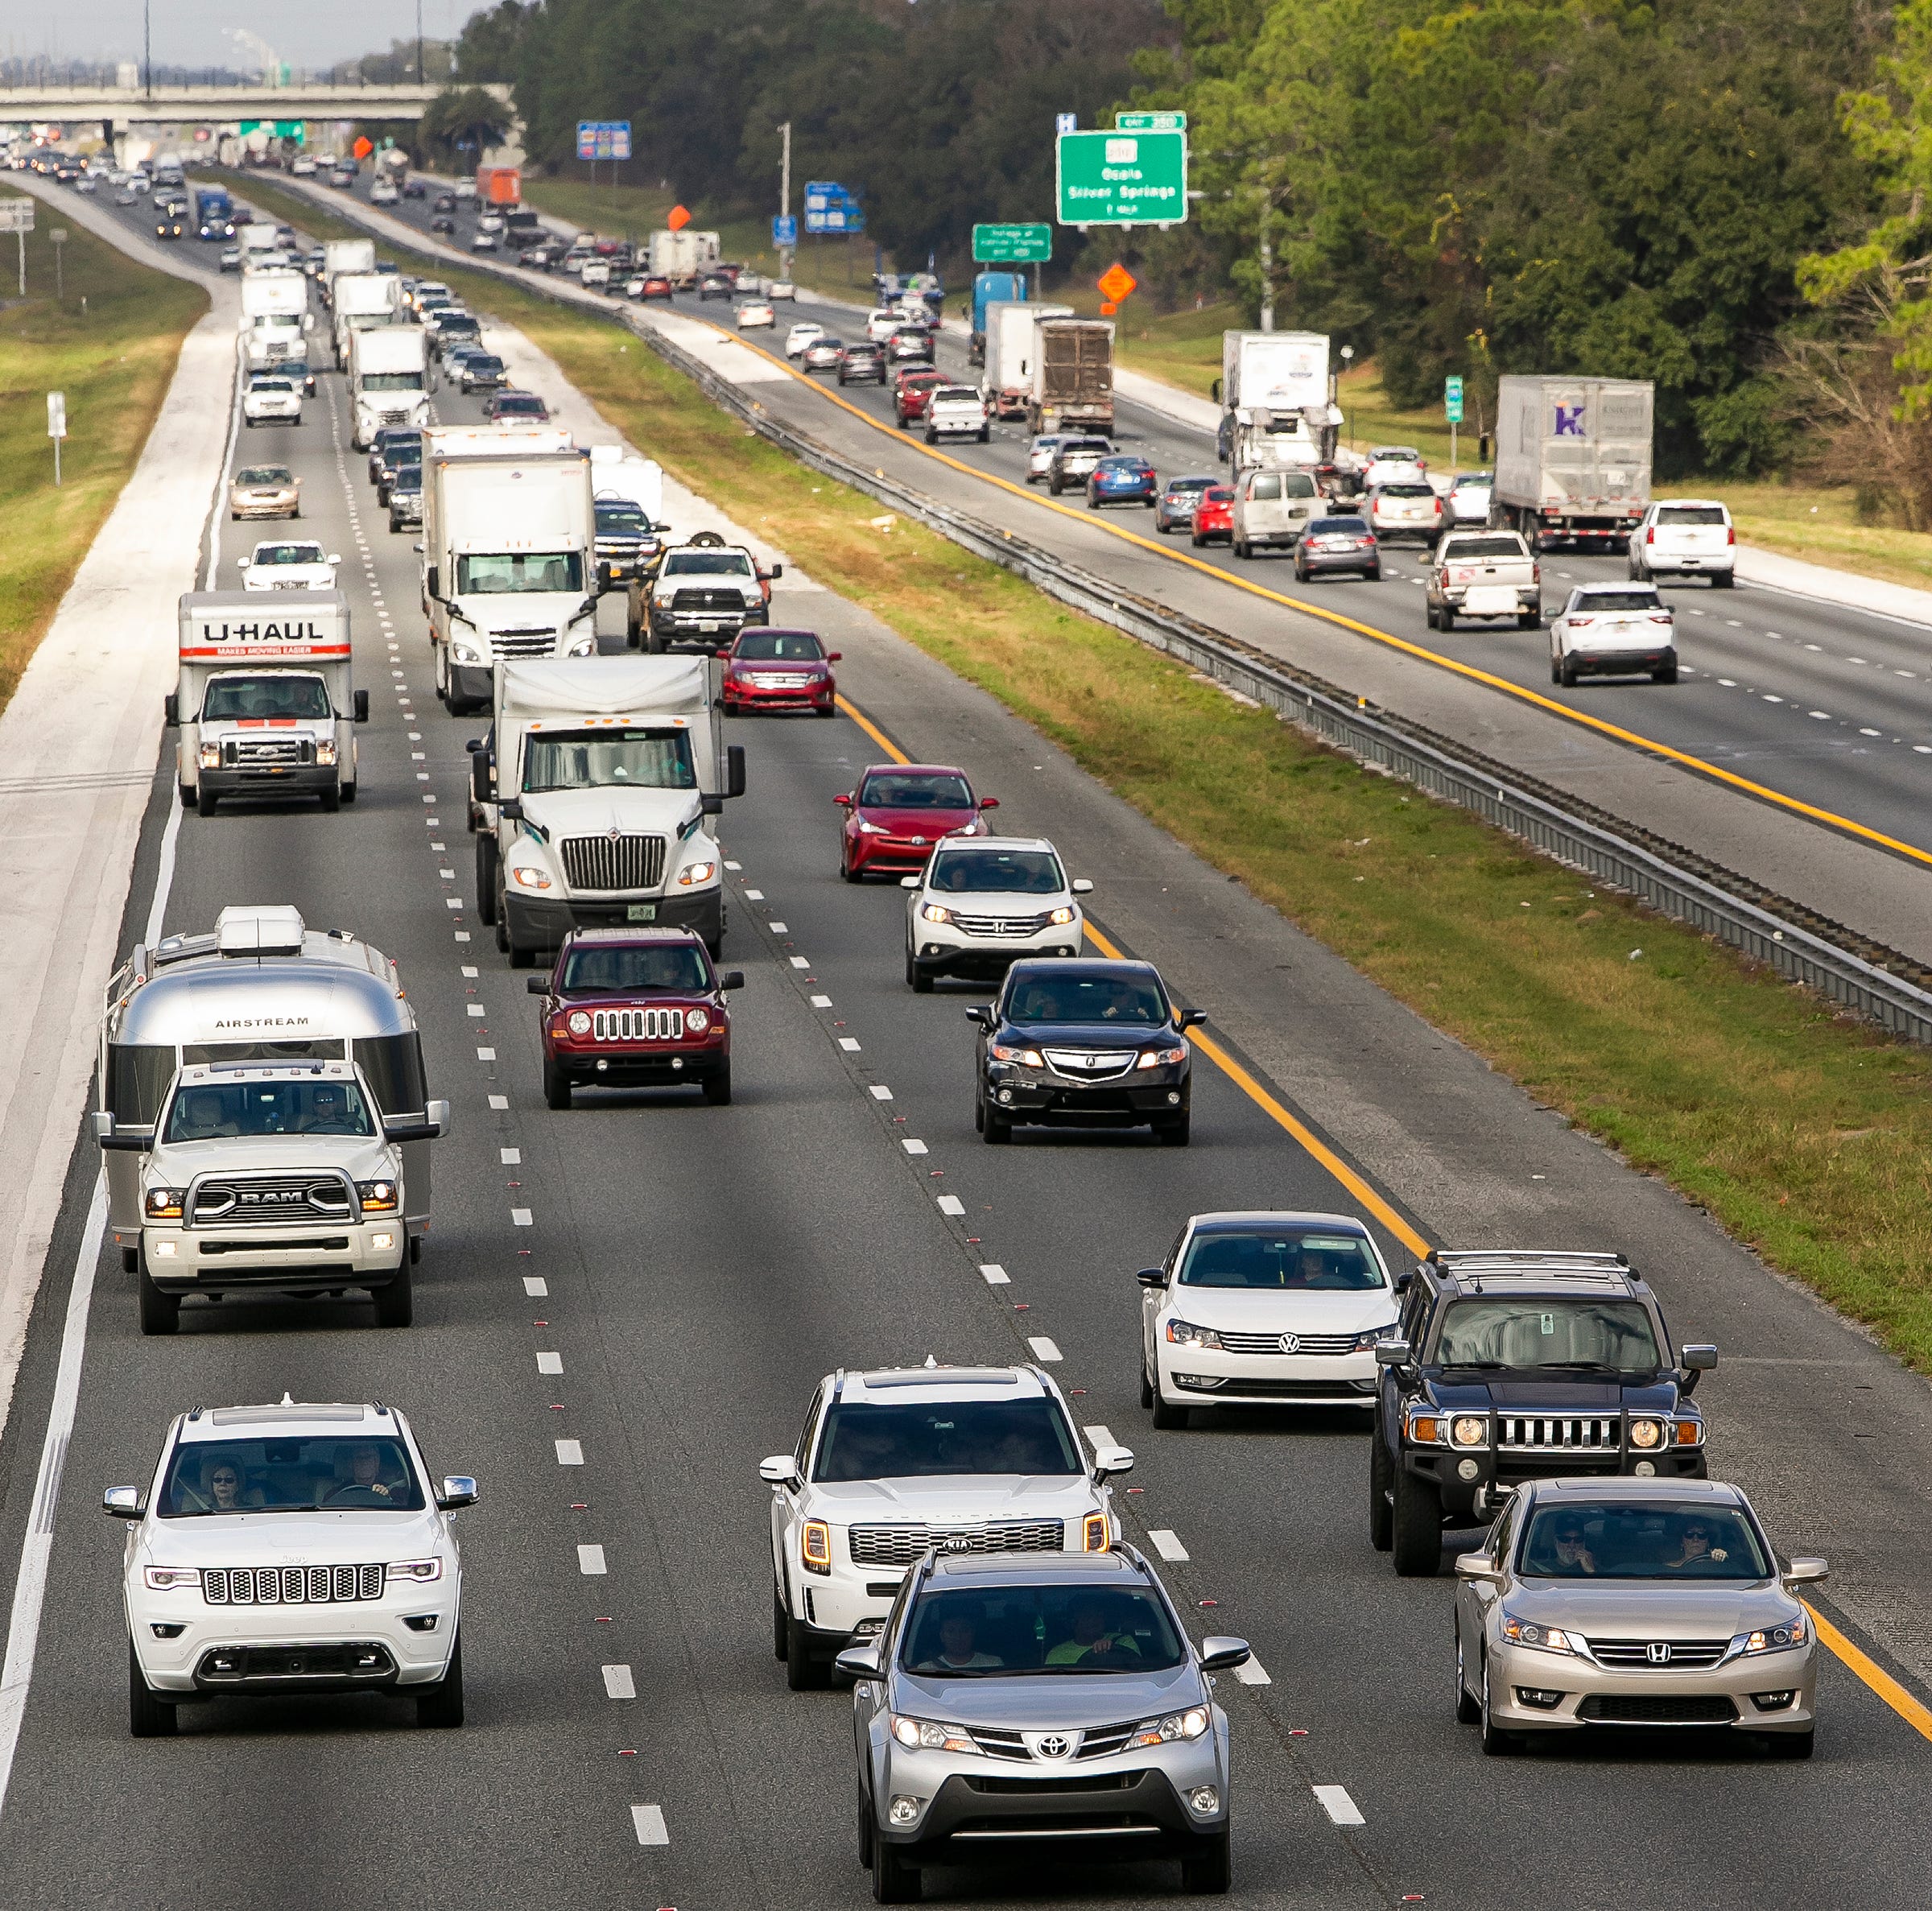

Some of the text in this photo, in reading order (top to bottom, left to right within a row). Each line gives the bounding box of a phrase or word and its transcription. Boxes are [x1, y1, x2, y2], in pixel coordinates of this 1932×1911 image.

[1068, 185, 1176, 200] Silver Springs
[204, 622, 324, 642] U-HAUL
[217, 646, 312, 655] MAKES MOVING EASIER
[215, 1017, 308, 1029] AIRSTREAM
[241, 1191, 302, 1203] RAM
[947, 1540, 967, 1550] KIA
[279, 1553, 308, 1566] Jeep
